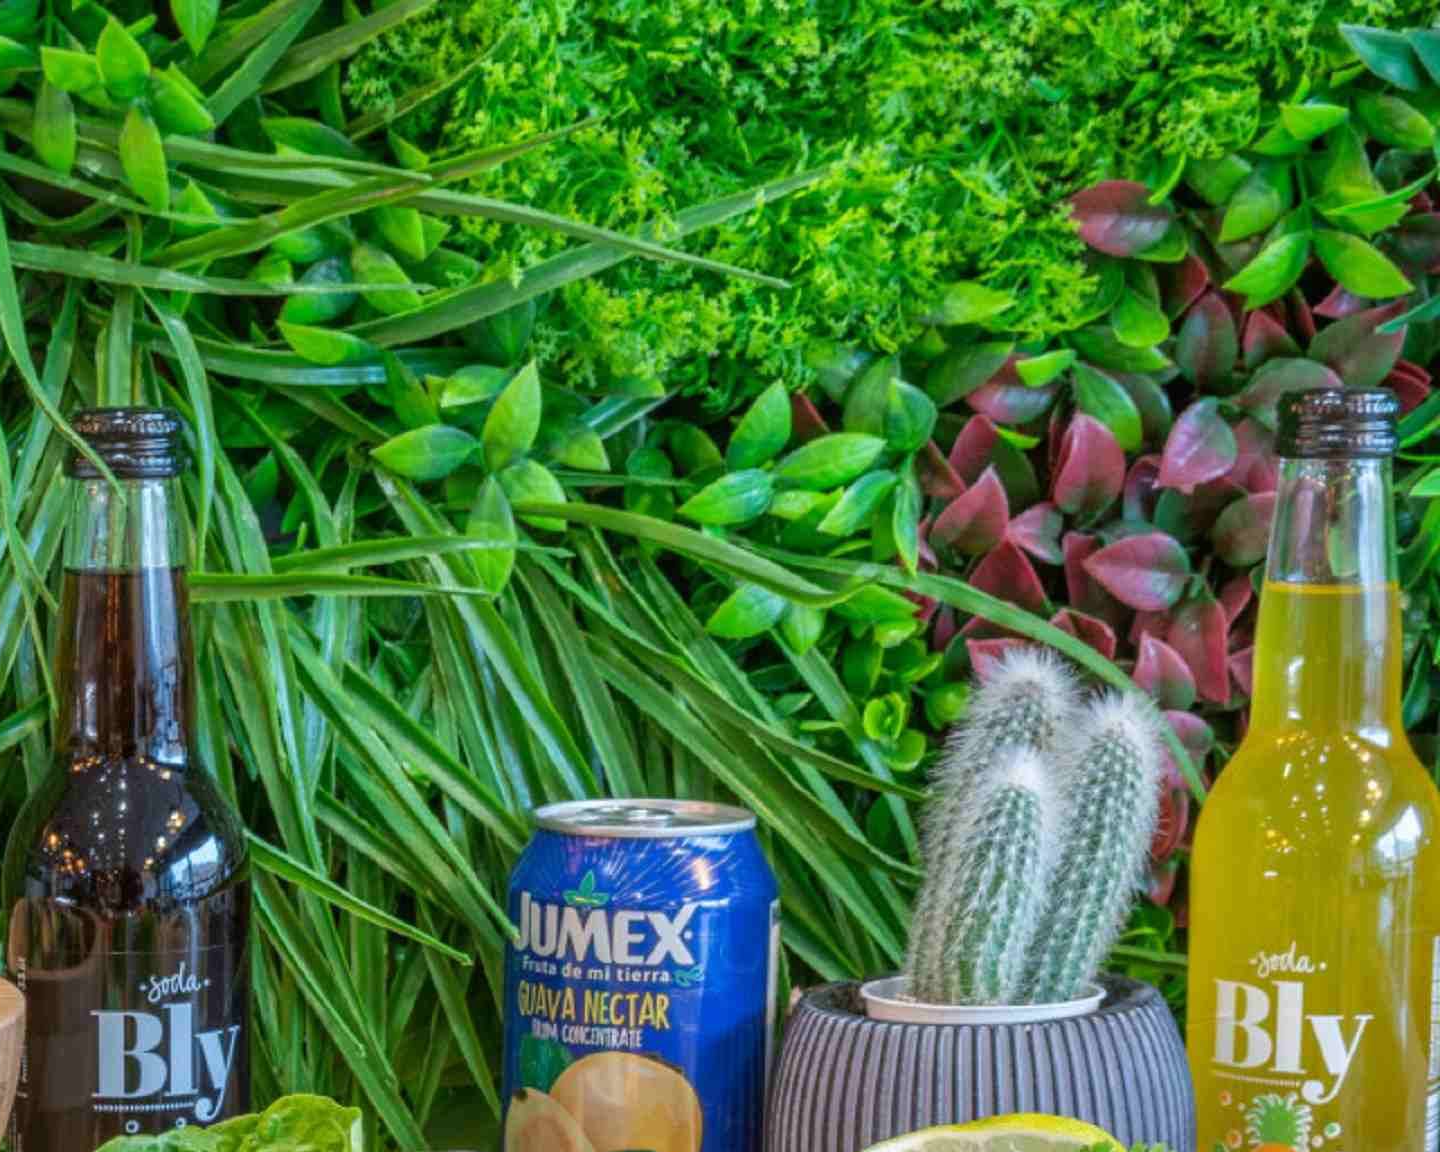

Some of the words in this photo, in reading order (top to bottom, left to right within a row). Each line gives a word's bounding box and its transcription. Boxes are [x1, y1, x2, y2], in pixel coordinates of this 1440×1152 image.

[510, 890, 698, 965] JUMEX
[562, 962, 583, 980] de
[587, 965, 610, 981] mi
[617, 966, 672, 983] tierra
[518, 979, 577, 1023] GUAVA
[584, 989, 671, 1030] NECTAR
[562, 1023, 643, 1049] CONCENTRATE
[90, 1002, 241, 1122] Bly
[1211, 978, 1375, 1105] Bly
